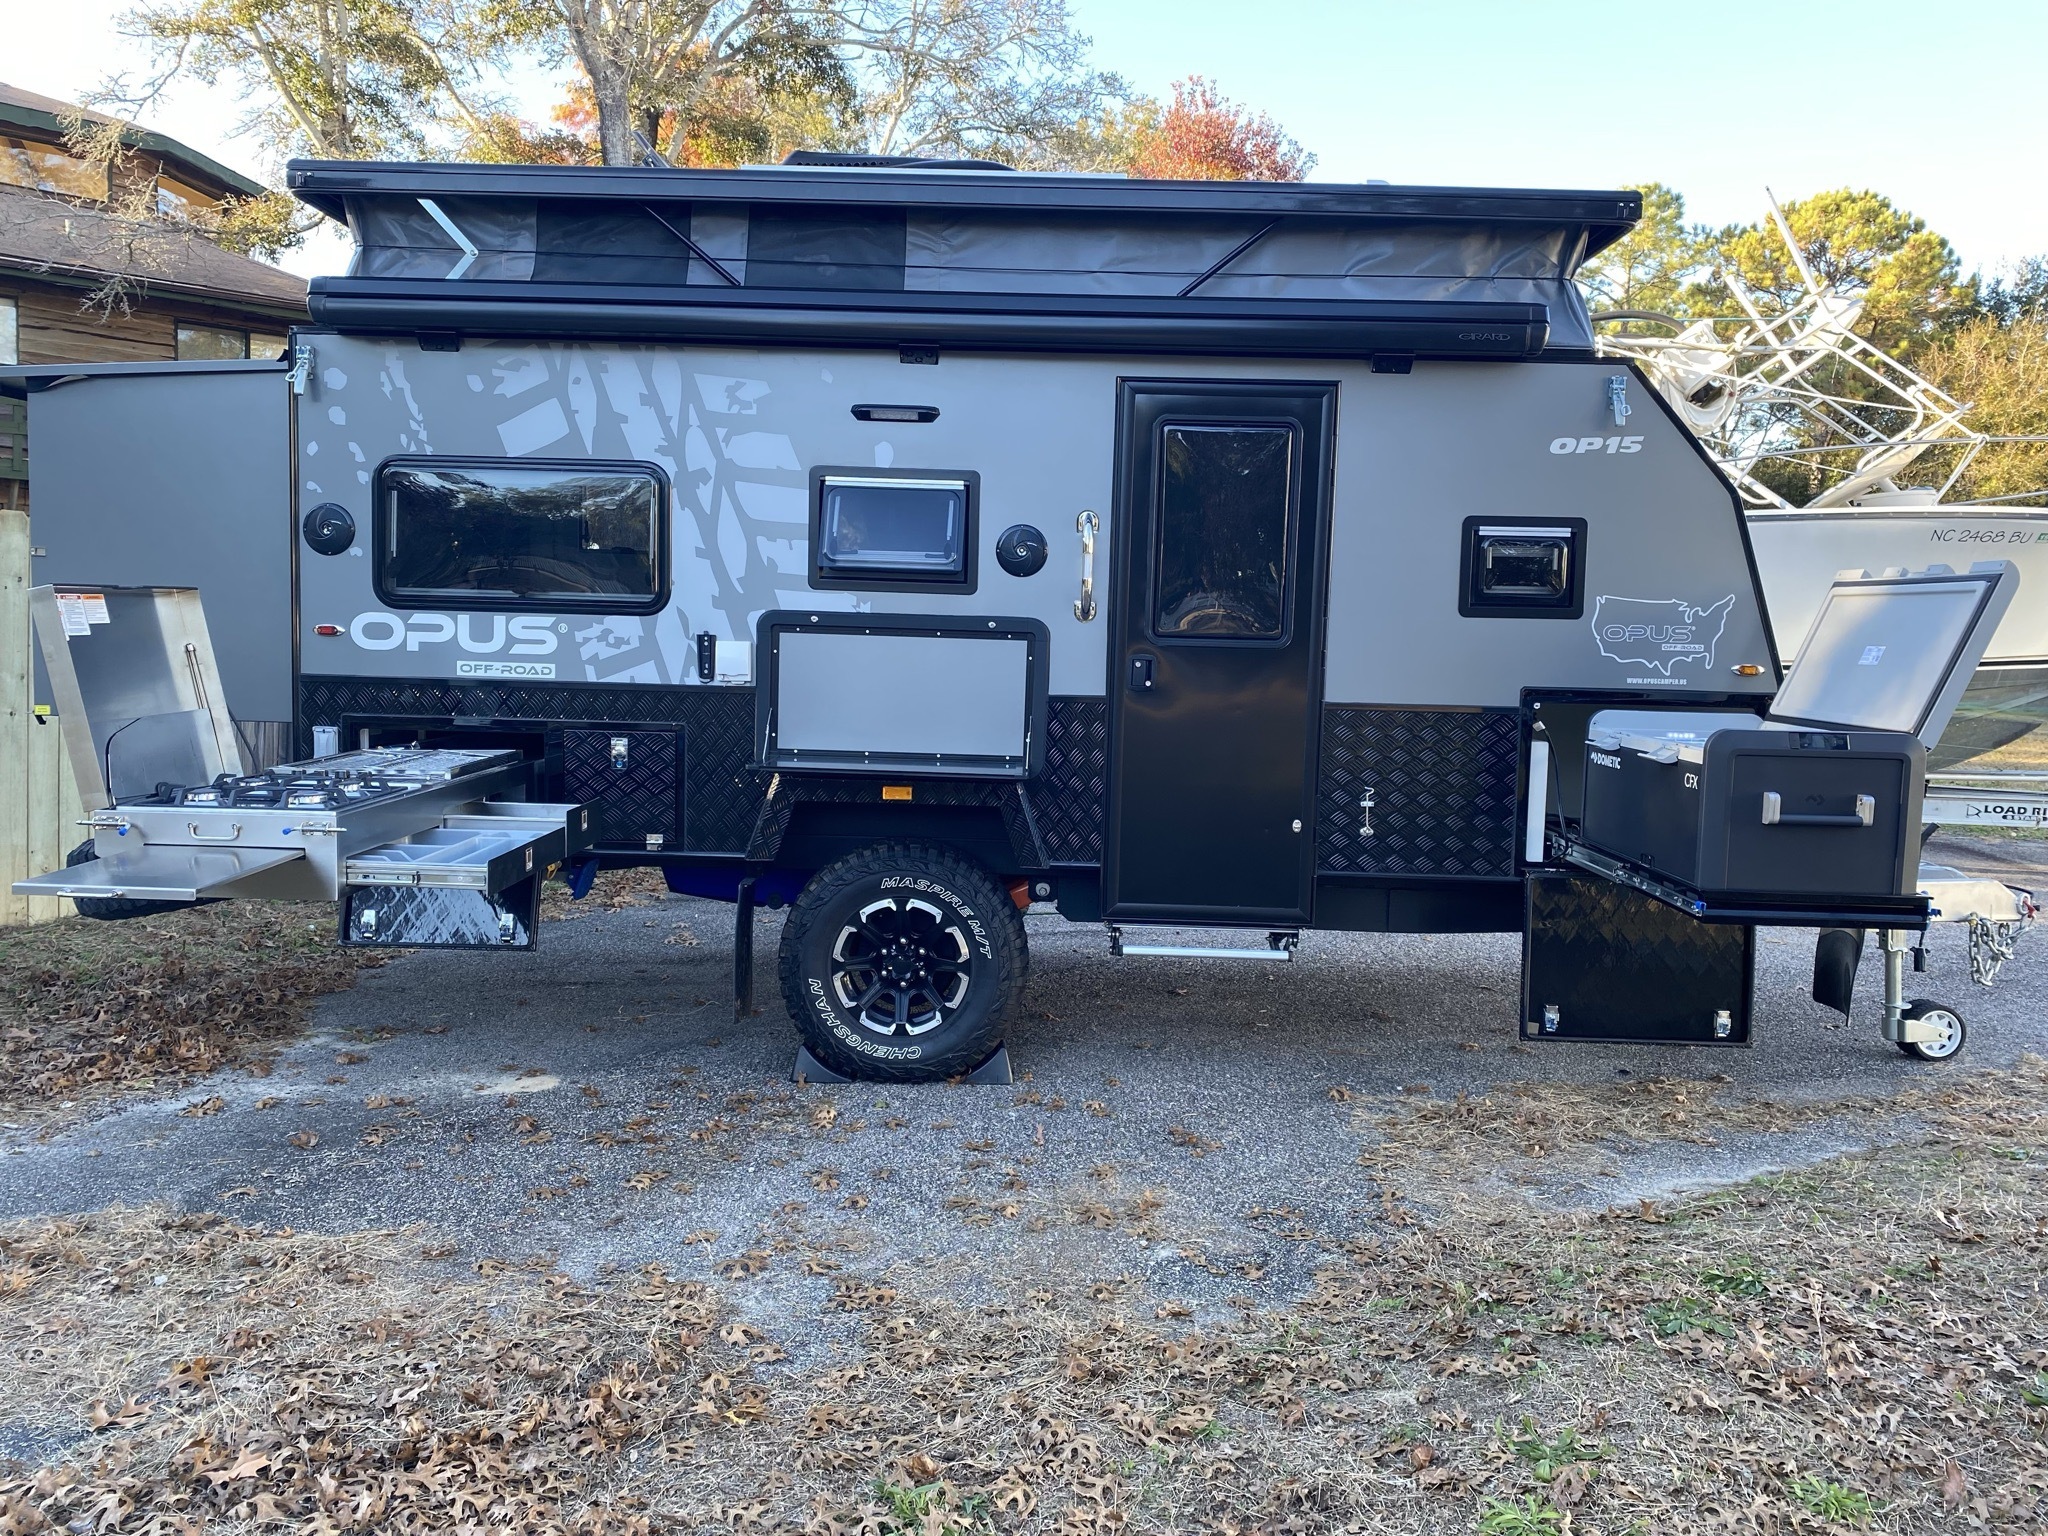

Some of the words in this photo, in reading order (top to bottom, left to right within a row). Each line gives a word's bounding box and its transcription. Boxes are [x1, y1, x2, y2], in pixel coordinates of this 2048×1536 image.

[1458, 333, 1511, 341] GIRARD
[1549, 436, 1645, 454] OP15
[1930, 529, 1956, 542] NC
[1958, 529, 2006, 543] 2468
[2008, 531, 2034, 543] BU
[459, 662, 553, 677] OFF-ROAD
[1598, 752, 1621, 770] DOMETIC
[1684, 773, 1699, 790] CFX
[1984, 805, 2028, 815] LOAD
[881, 876, 974, 918] MASPIRE
[968, 919, 992, 959] M/T
[808, 978, 922, 1060] CHENGSHAN
